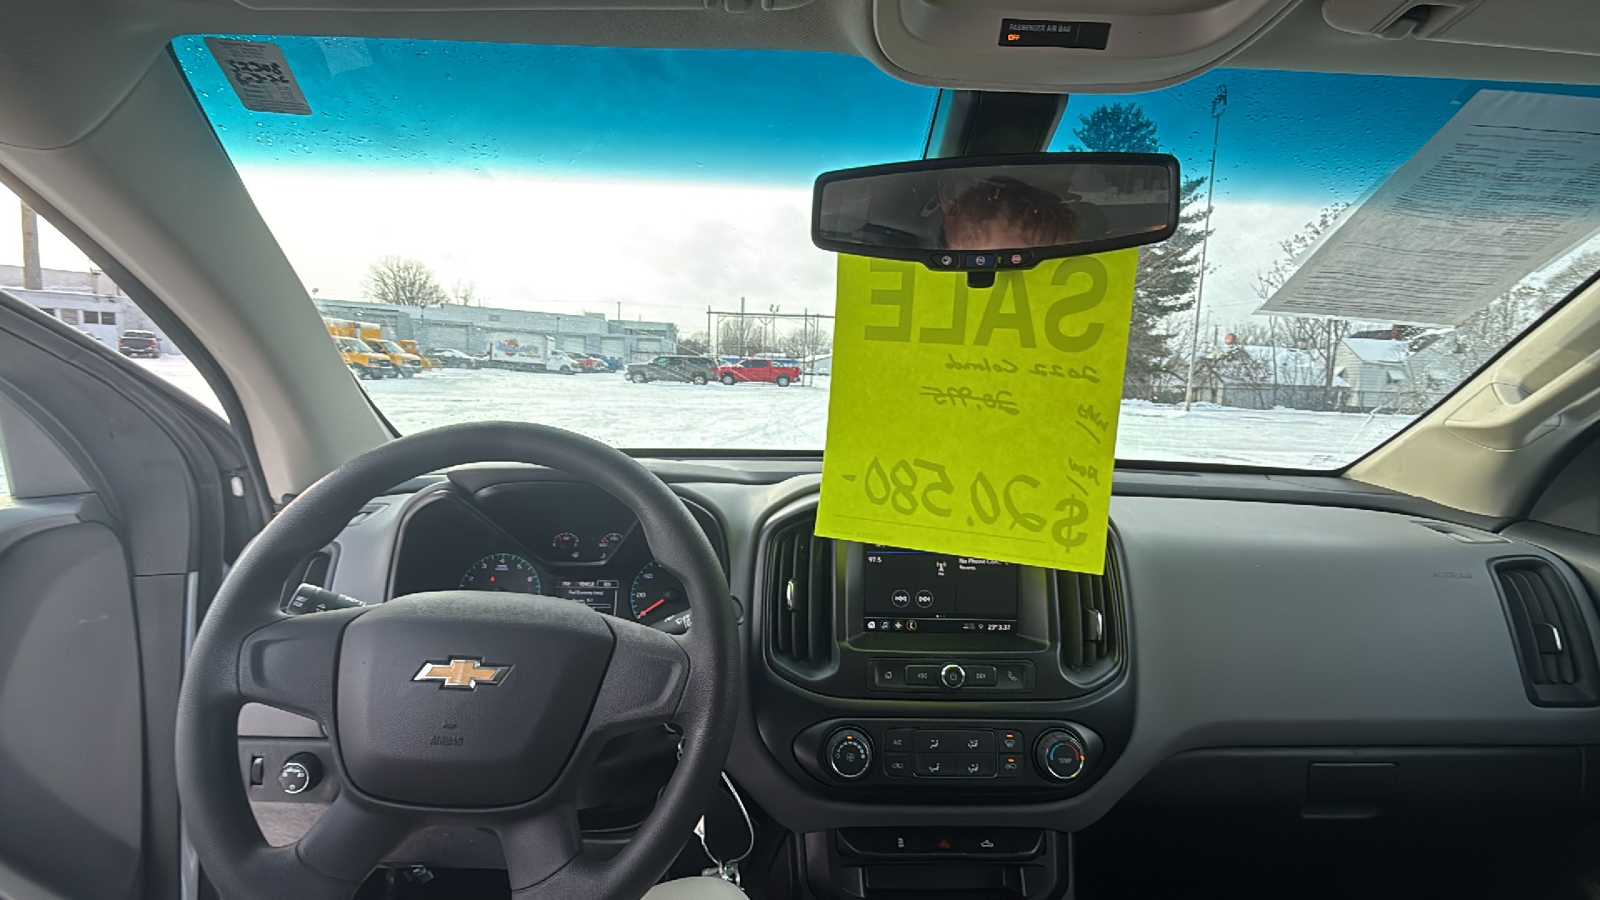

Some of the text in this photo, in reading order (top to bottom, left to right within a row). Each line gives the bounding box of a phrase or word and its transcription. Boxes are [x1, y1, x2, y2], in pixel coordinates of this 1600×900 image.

[1008, 23, 1072, 33] PASSENGER AIR BAG
[1007, 33, 1021, 42] OFF
